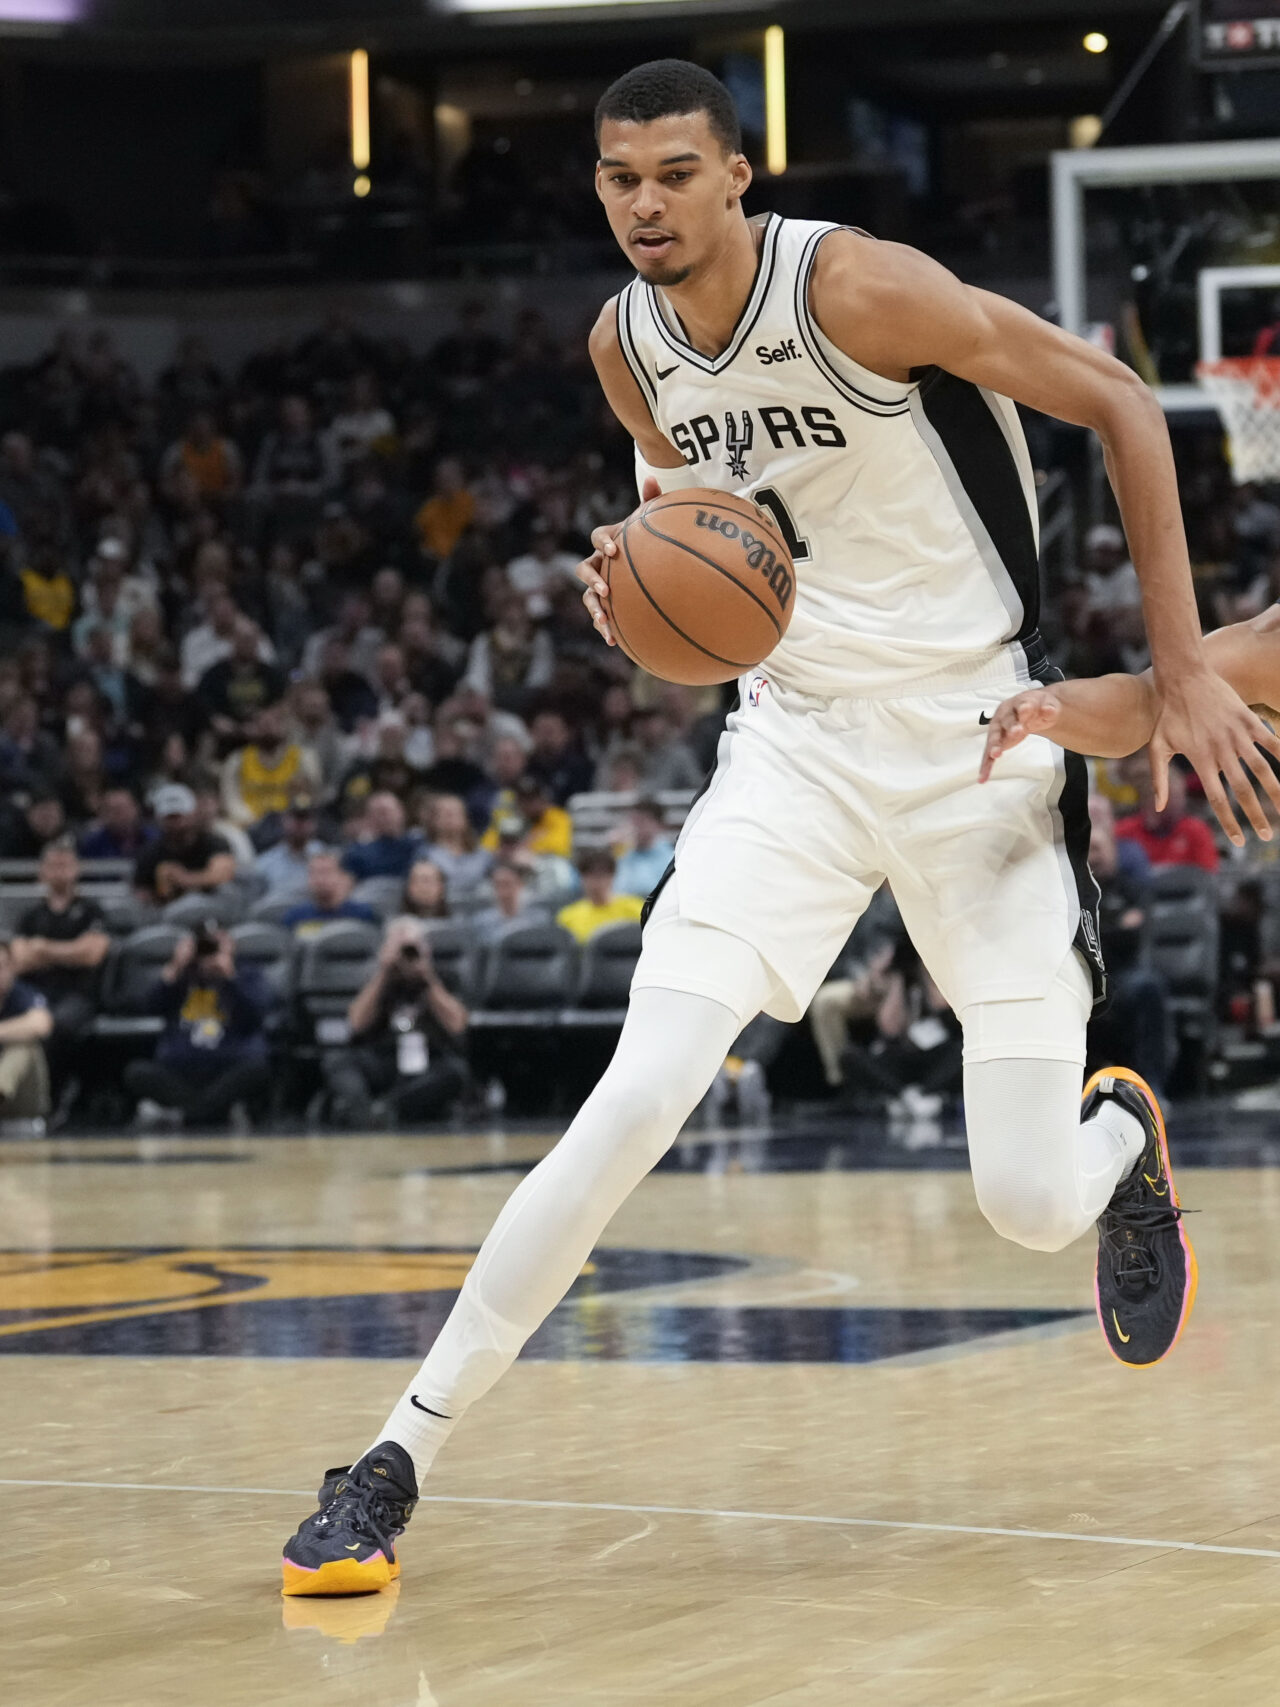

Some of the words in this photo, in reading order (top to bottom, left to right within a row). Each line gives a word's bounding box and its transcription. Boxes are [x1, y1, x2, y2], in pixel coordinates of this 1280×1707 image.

[755, 339, 802, 366] Self.
[671, 406, 847, 481] SPURS
[751, 485, 813, 564] 1
